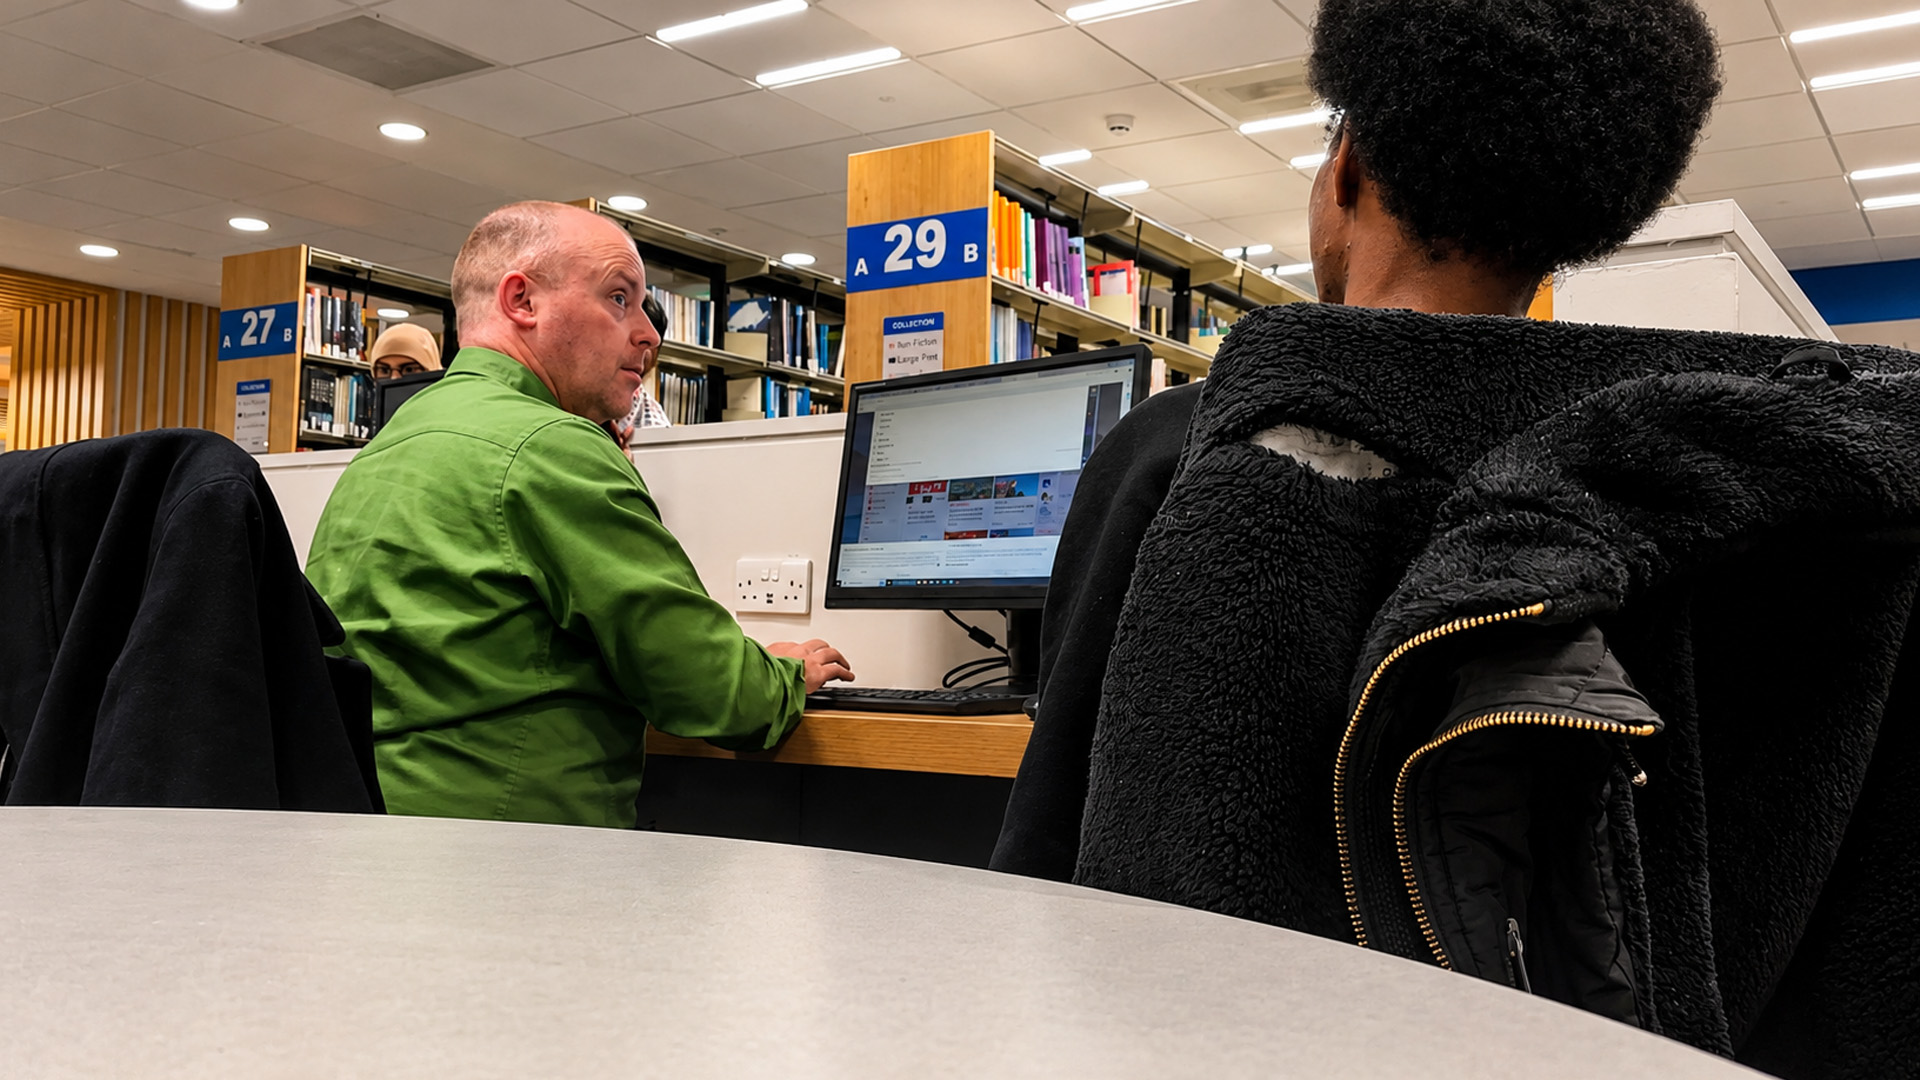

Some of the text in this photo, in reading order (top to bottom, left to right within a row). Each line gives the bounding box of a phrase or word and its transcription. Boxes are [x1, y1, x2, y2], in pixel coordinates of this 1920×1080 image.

[854, 218, 979, 276] A 29 B
[223, 308, 292, 348] A 27 B
